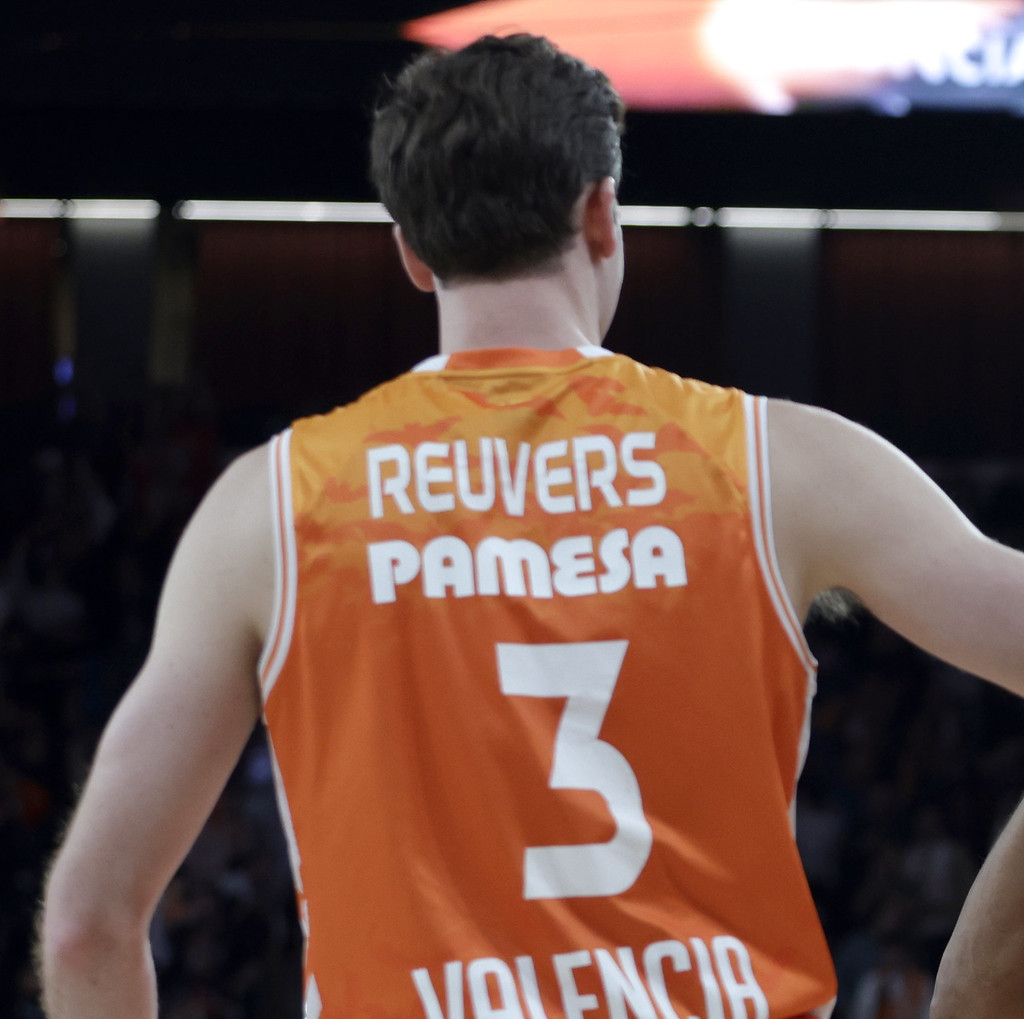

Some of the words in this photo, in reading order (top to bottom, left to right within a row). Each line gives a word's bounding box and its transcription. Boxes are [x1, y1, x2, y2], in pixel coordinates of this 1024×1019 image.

[367, 431, 667, 519] REUVERS
[367, 525, 688, 604] PAMESA
[496, 640, 653, 899] 3
